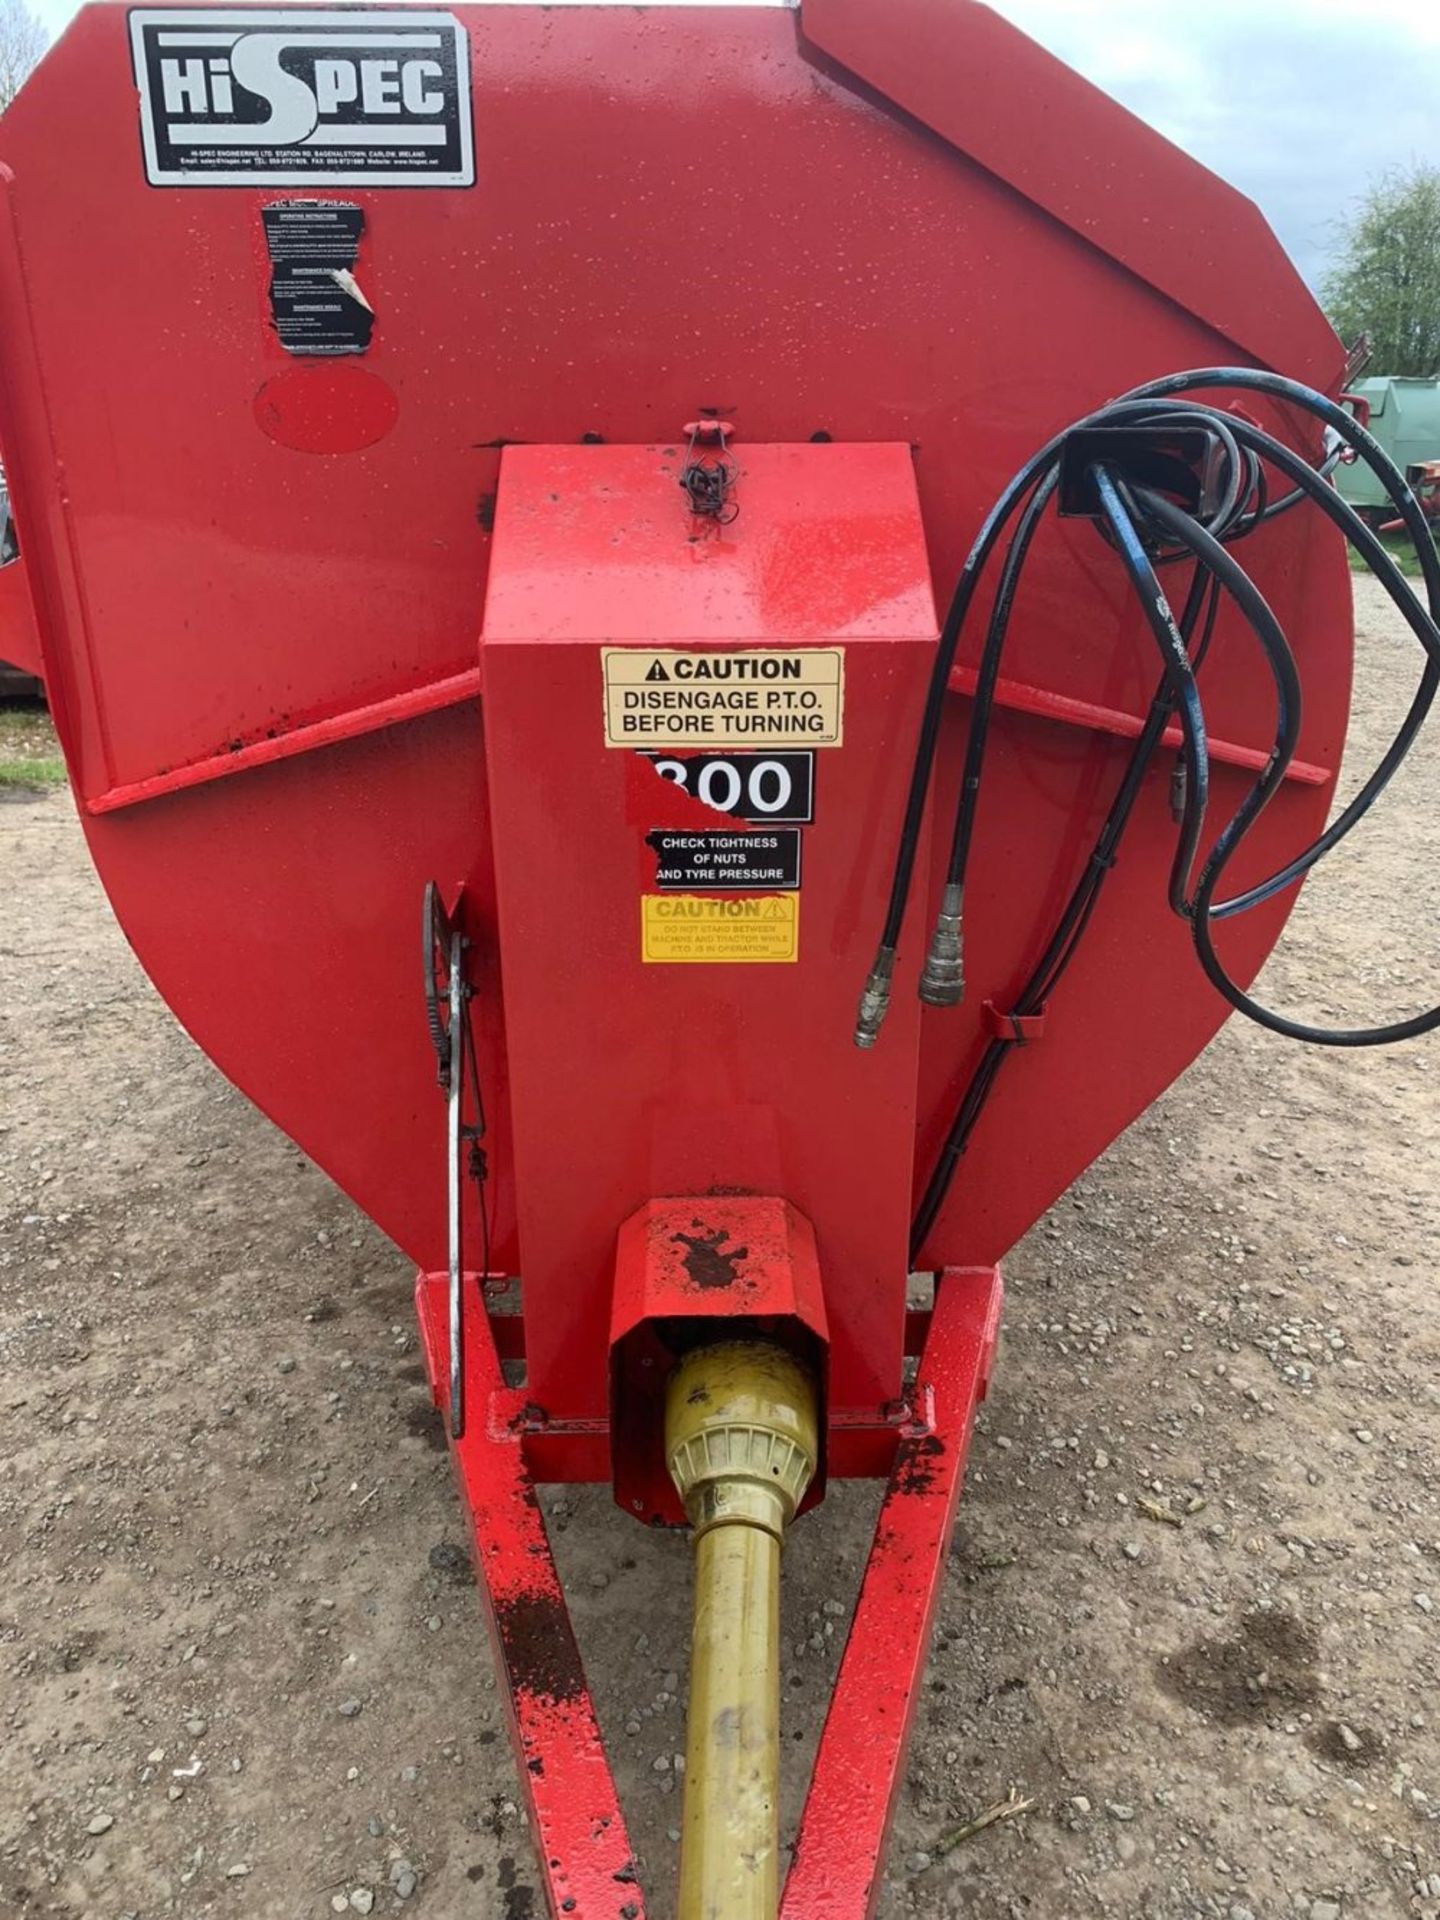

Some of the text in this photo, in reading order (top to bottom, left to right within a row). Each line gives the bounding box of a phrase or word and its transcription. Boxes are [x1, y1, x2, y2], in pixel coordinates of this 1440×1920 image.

[674, 658, 801, 680] CAUTION
[624, 690, 823, 710] DISENGAGE P.T.O.
[623, 714, 825, 733] BEFORE TURNING
[662, 837, 778, 849] CHECK TIGHTNESS
[693, 853, 747, 864] OF NUTS
[656, 868, 784, 880] AND TYRE PRESSURE
[655, 900, 760, 917] CAUTION
[679, 925, 697, 933] NOT
[701, 925, 730, 933] STAND
[733, 925, 776, 933] BETWEEN
[652, 935, 788, 943] MACHINE AND TRACTOR WHILE
[718, 944, 770, 953] OPERATION
